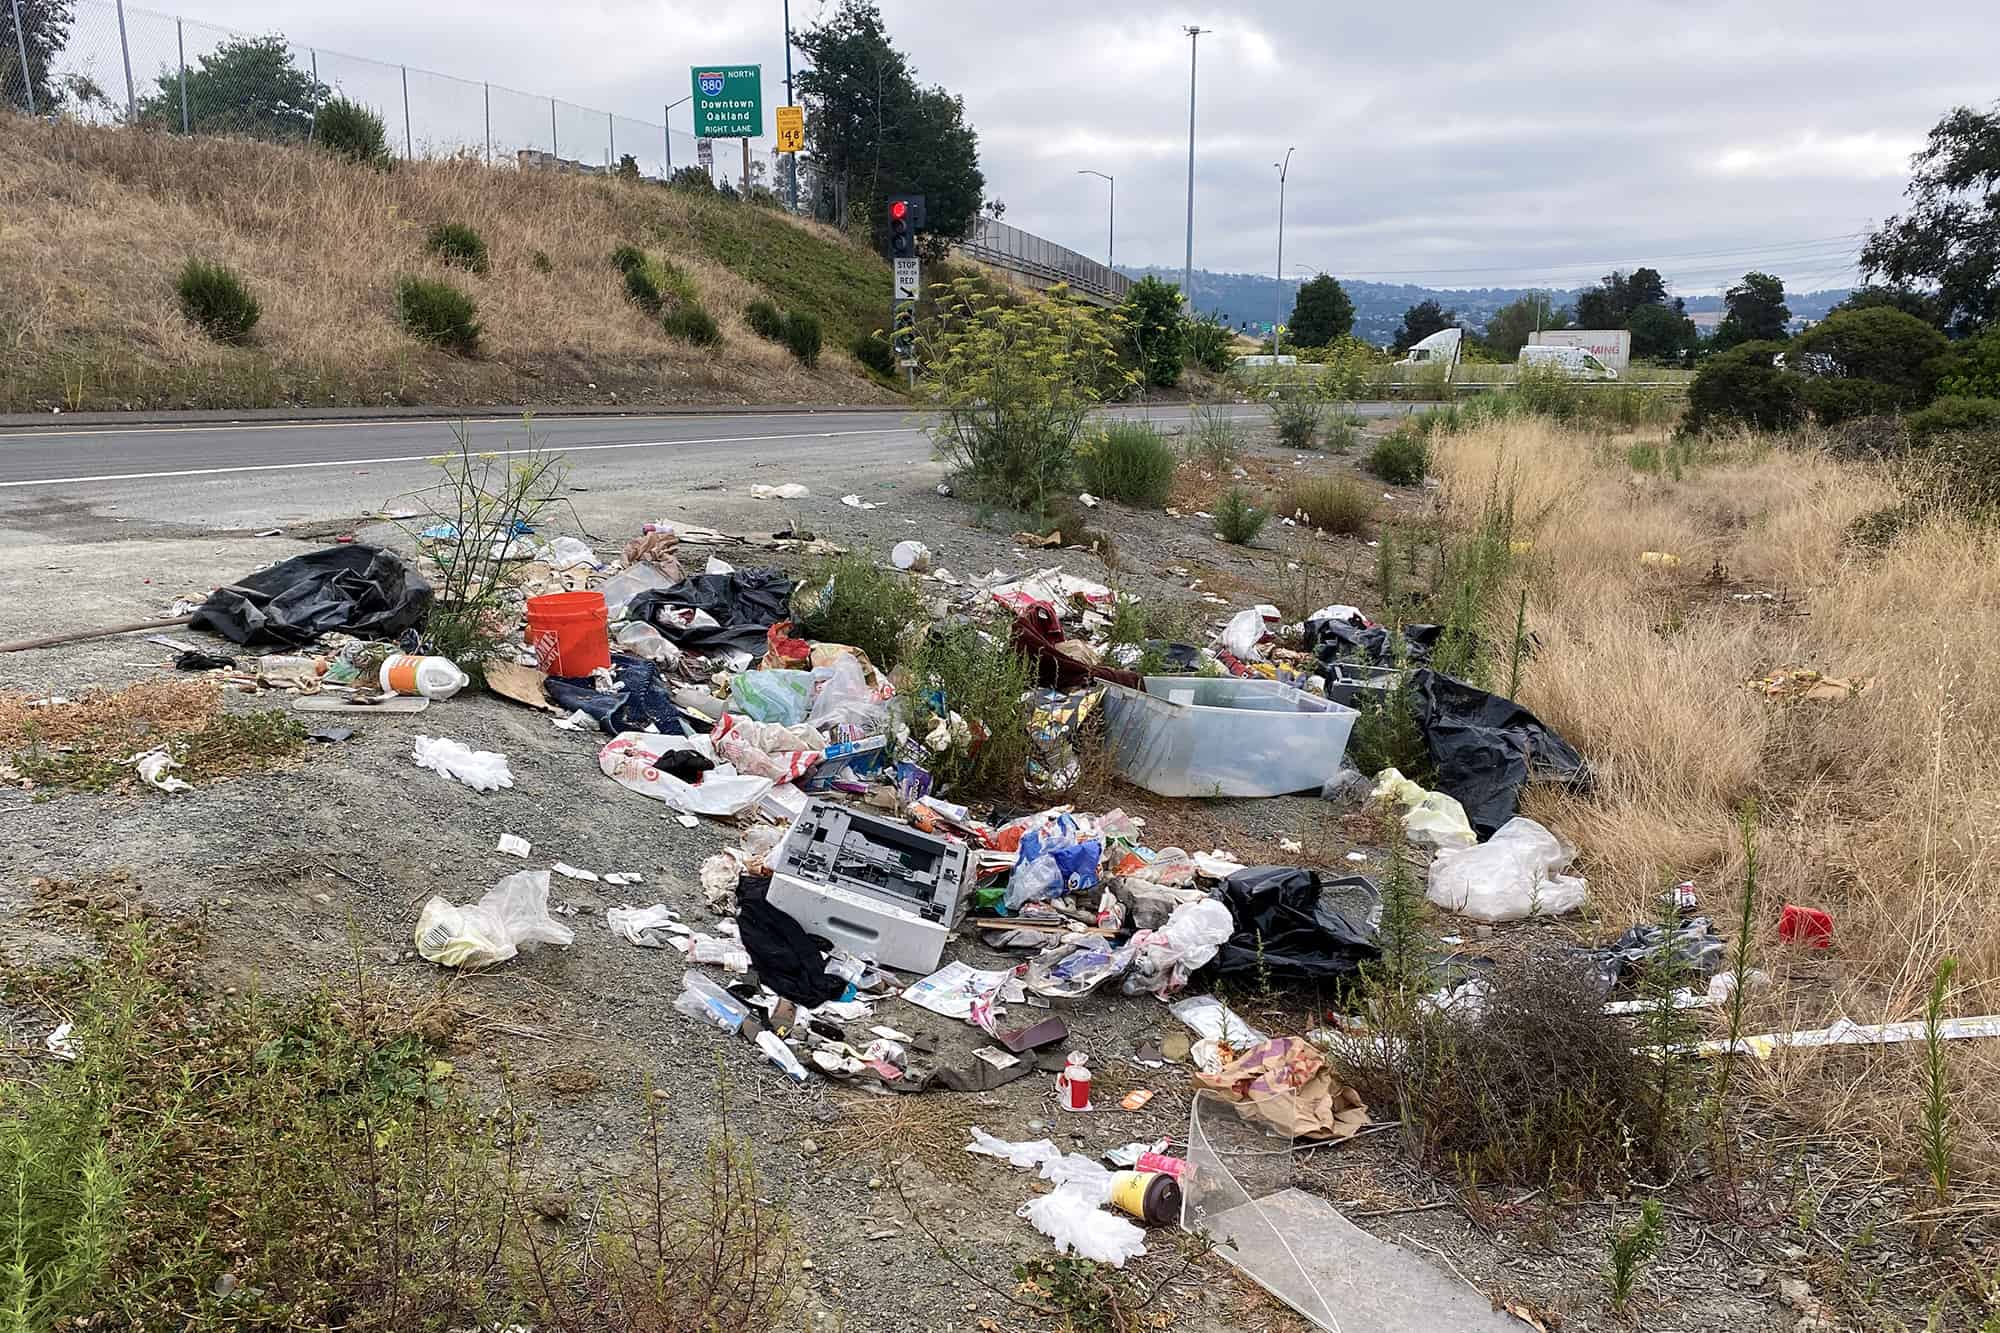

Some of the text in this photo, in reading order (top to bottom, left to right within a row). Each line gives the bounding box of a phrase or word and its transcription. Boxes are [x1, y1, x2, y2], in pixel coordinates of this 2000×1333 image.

[728, 70, 754, 78] NORTH
[703, 79, 721, 90] 880
[701, 100, 754, 109] Downtown
[706, 112, 750, 121] Oakland
[705, 125, 753, 134] RIGHT LANE
[897, 261, 917, 269] STOP
[900, 276, 914, 285] RED
